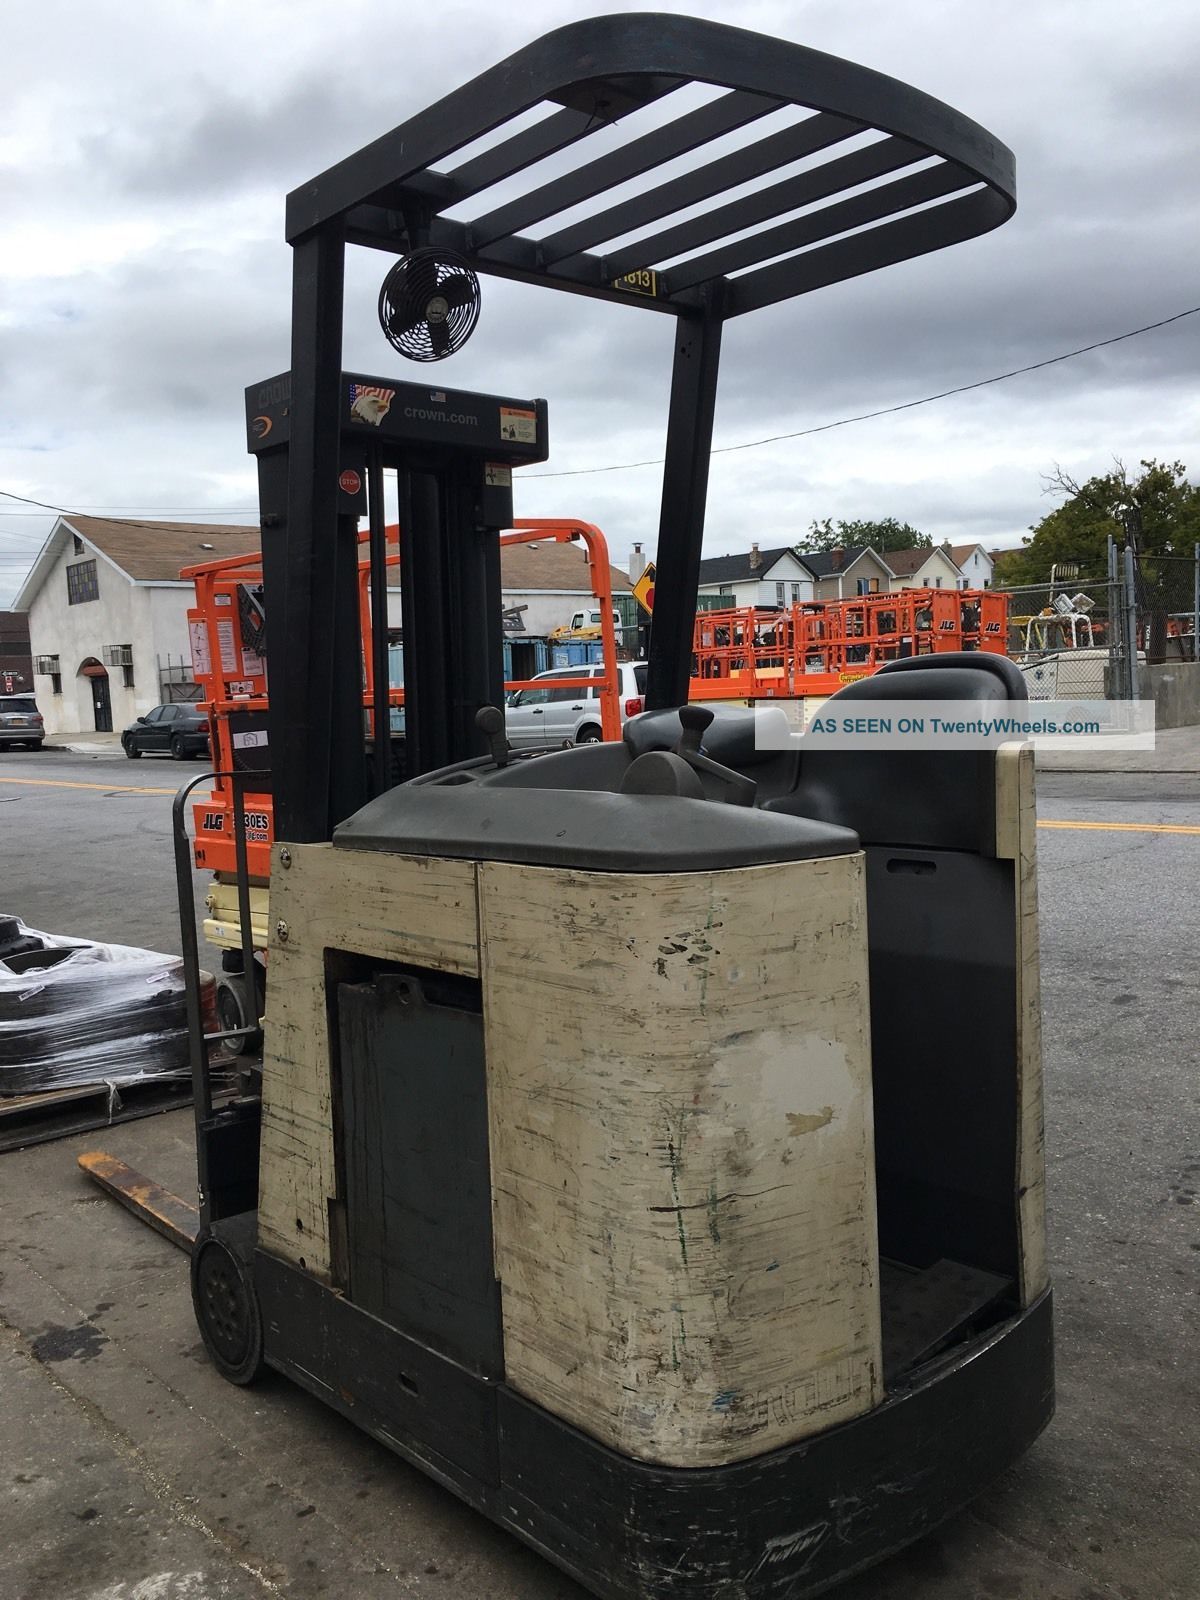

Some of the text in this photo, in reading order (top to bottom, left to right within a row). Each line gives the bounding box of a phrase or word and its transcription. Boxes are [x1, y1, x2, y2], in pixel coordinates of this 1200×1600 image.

[404, 406, 478, 425] crown.com
[939, 620, 955, 631] JLG
[985, 622, 1001, 632] JLG
[203, 813, 223, 830] JLG
